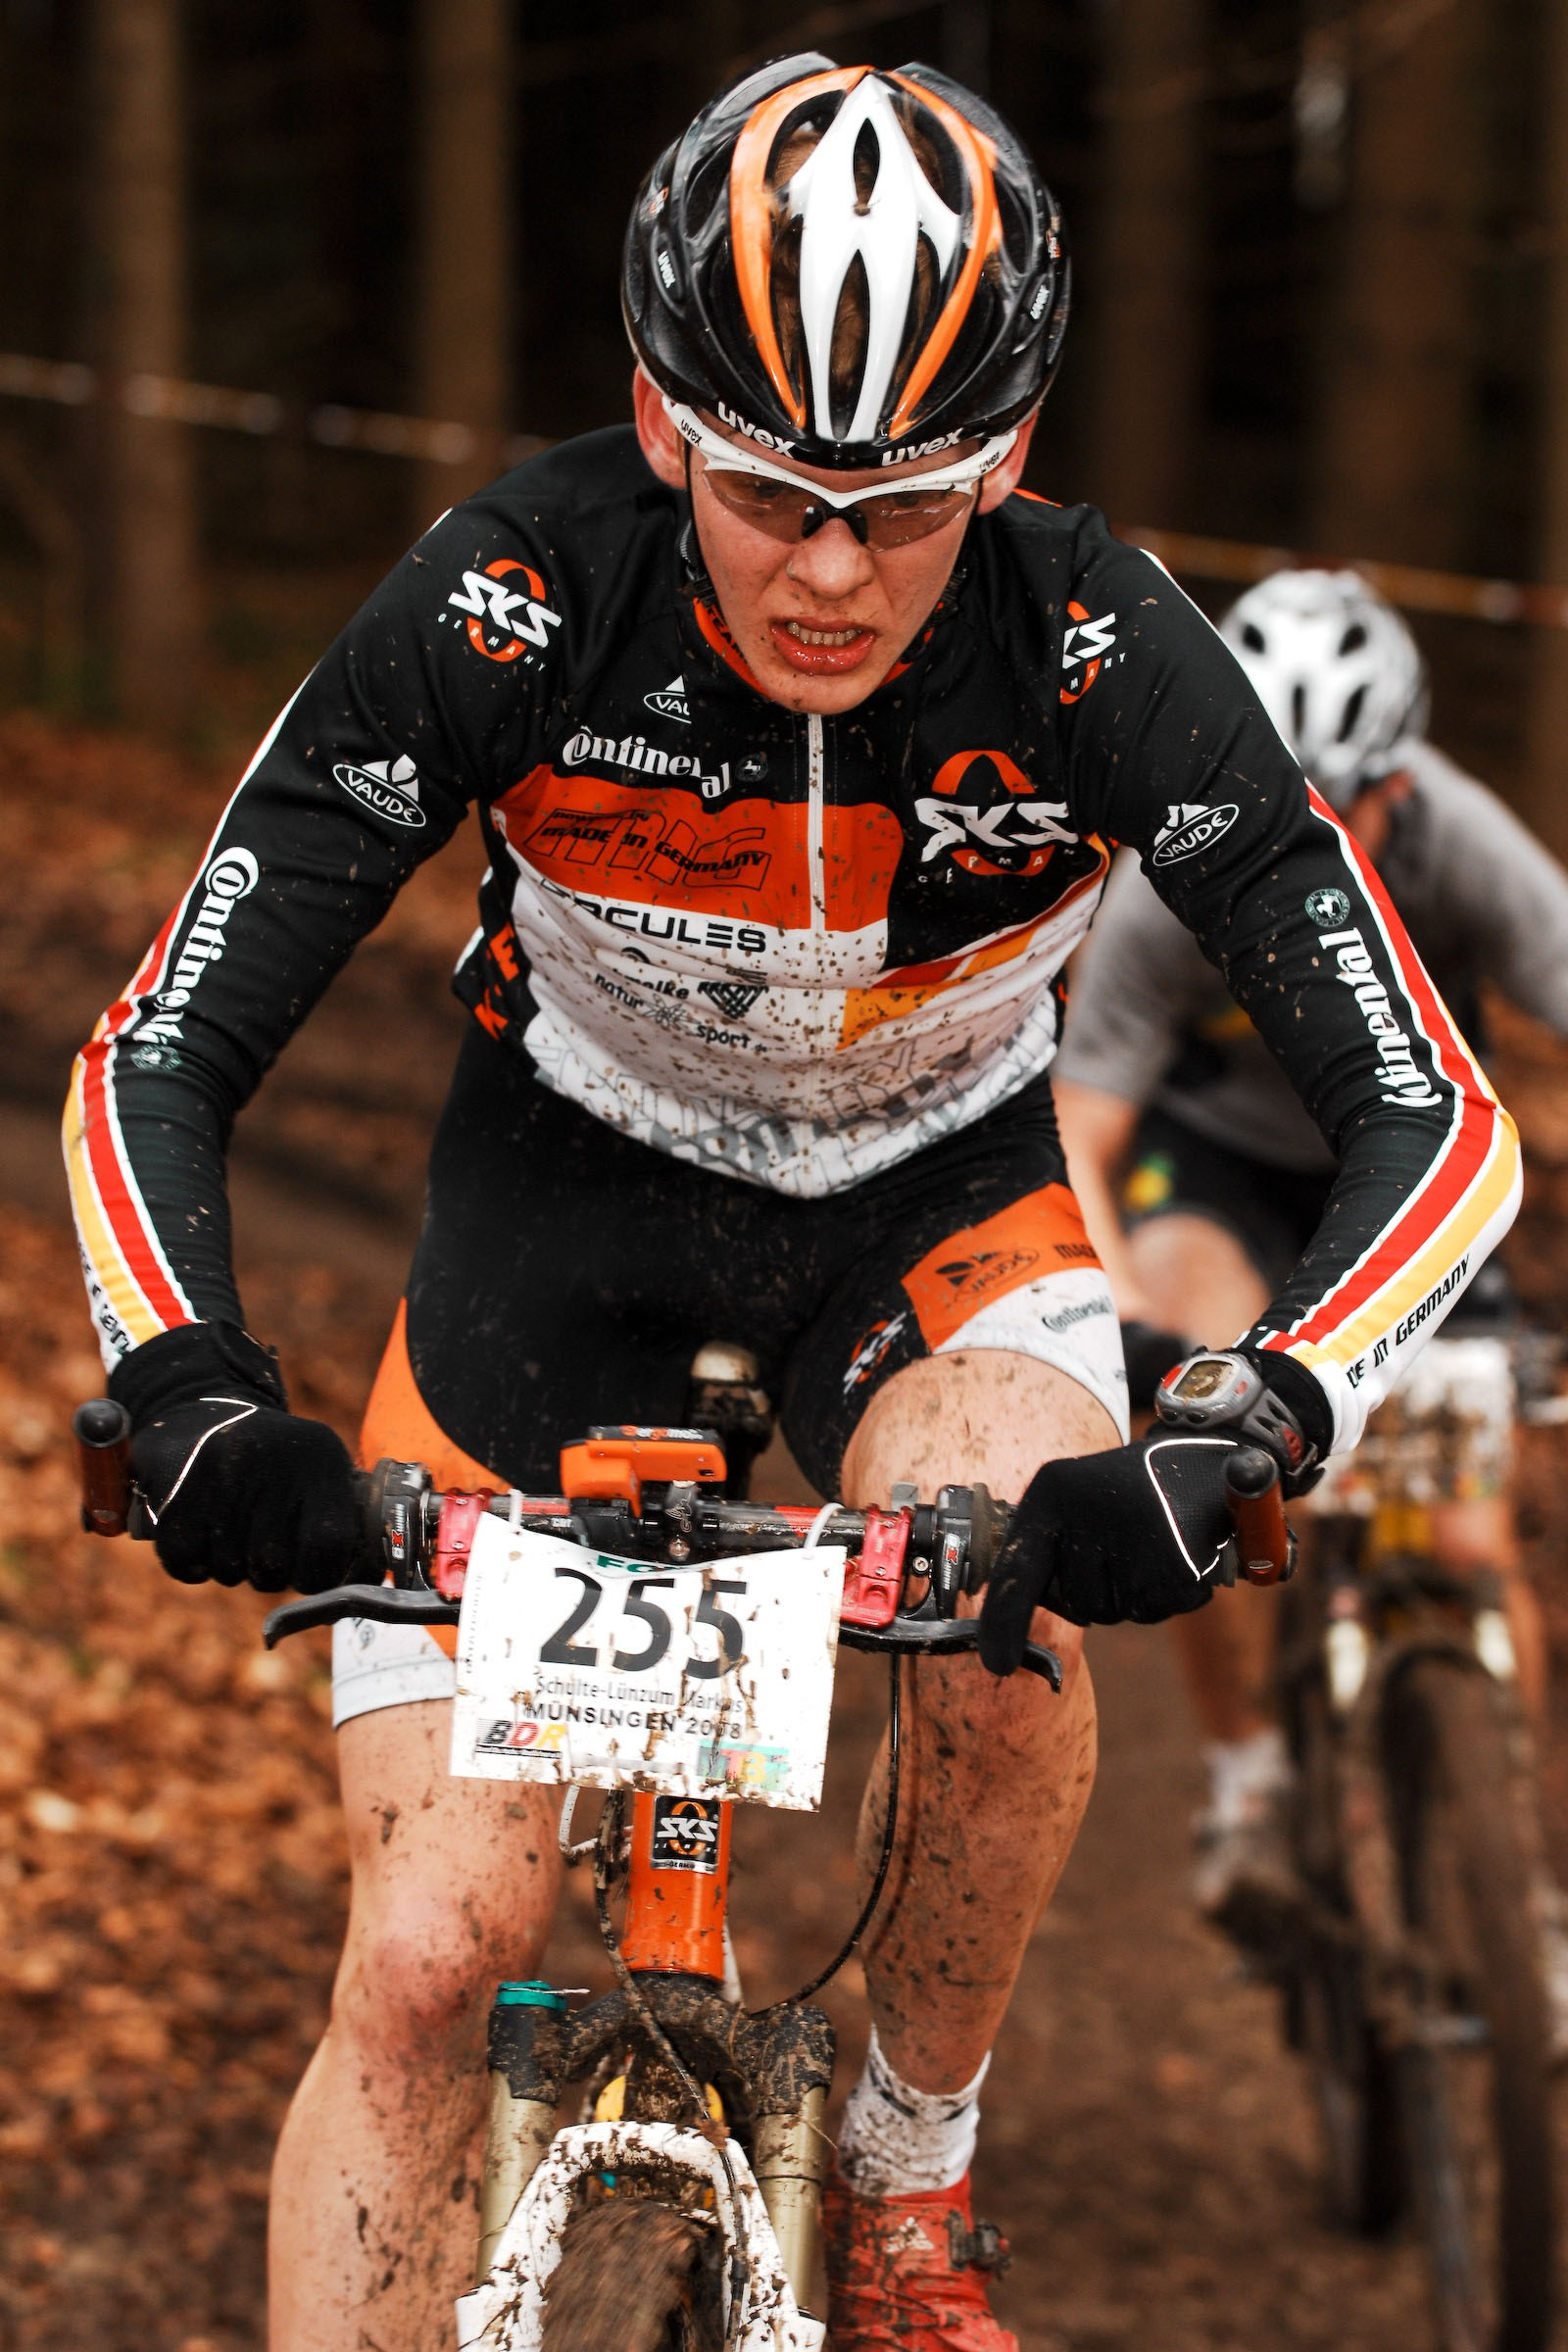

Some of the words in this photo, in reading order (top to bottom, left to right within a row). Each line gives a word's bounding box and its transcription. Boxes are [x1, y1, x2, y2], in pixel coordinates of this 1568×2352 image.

[717, 401, 796, 459] uvex
[881, 426, 963, 466] uvex
[448, 569, 563, 649] SKS
[346, 769, 415, 823] VAUDE
[913, 797, 1079, 863] SKS
[1157, 810, 1229, 858] VAUDE
[539, 1567, 747, 1679] 255
[484, 1718, 567, 1750] BDR
[657, 1817, 719, 1842] SKS
